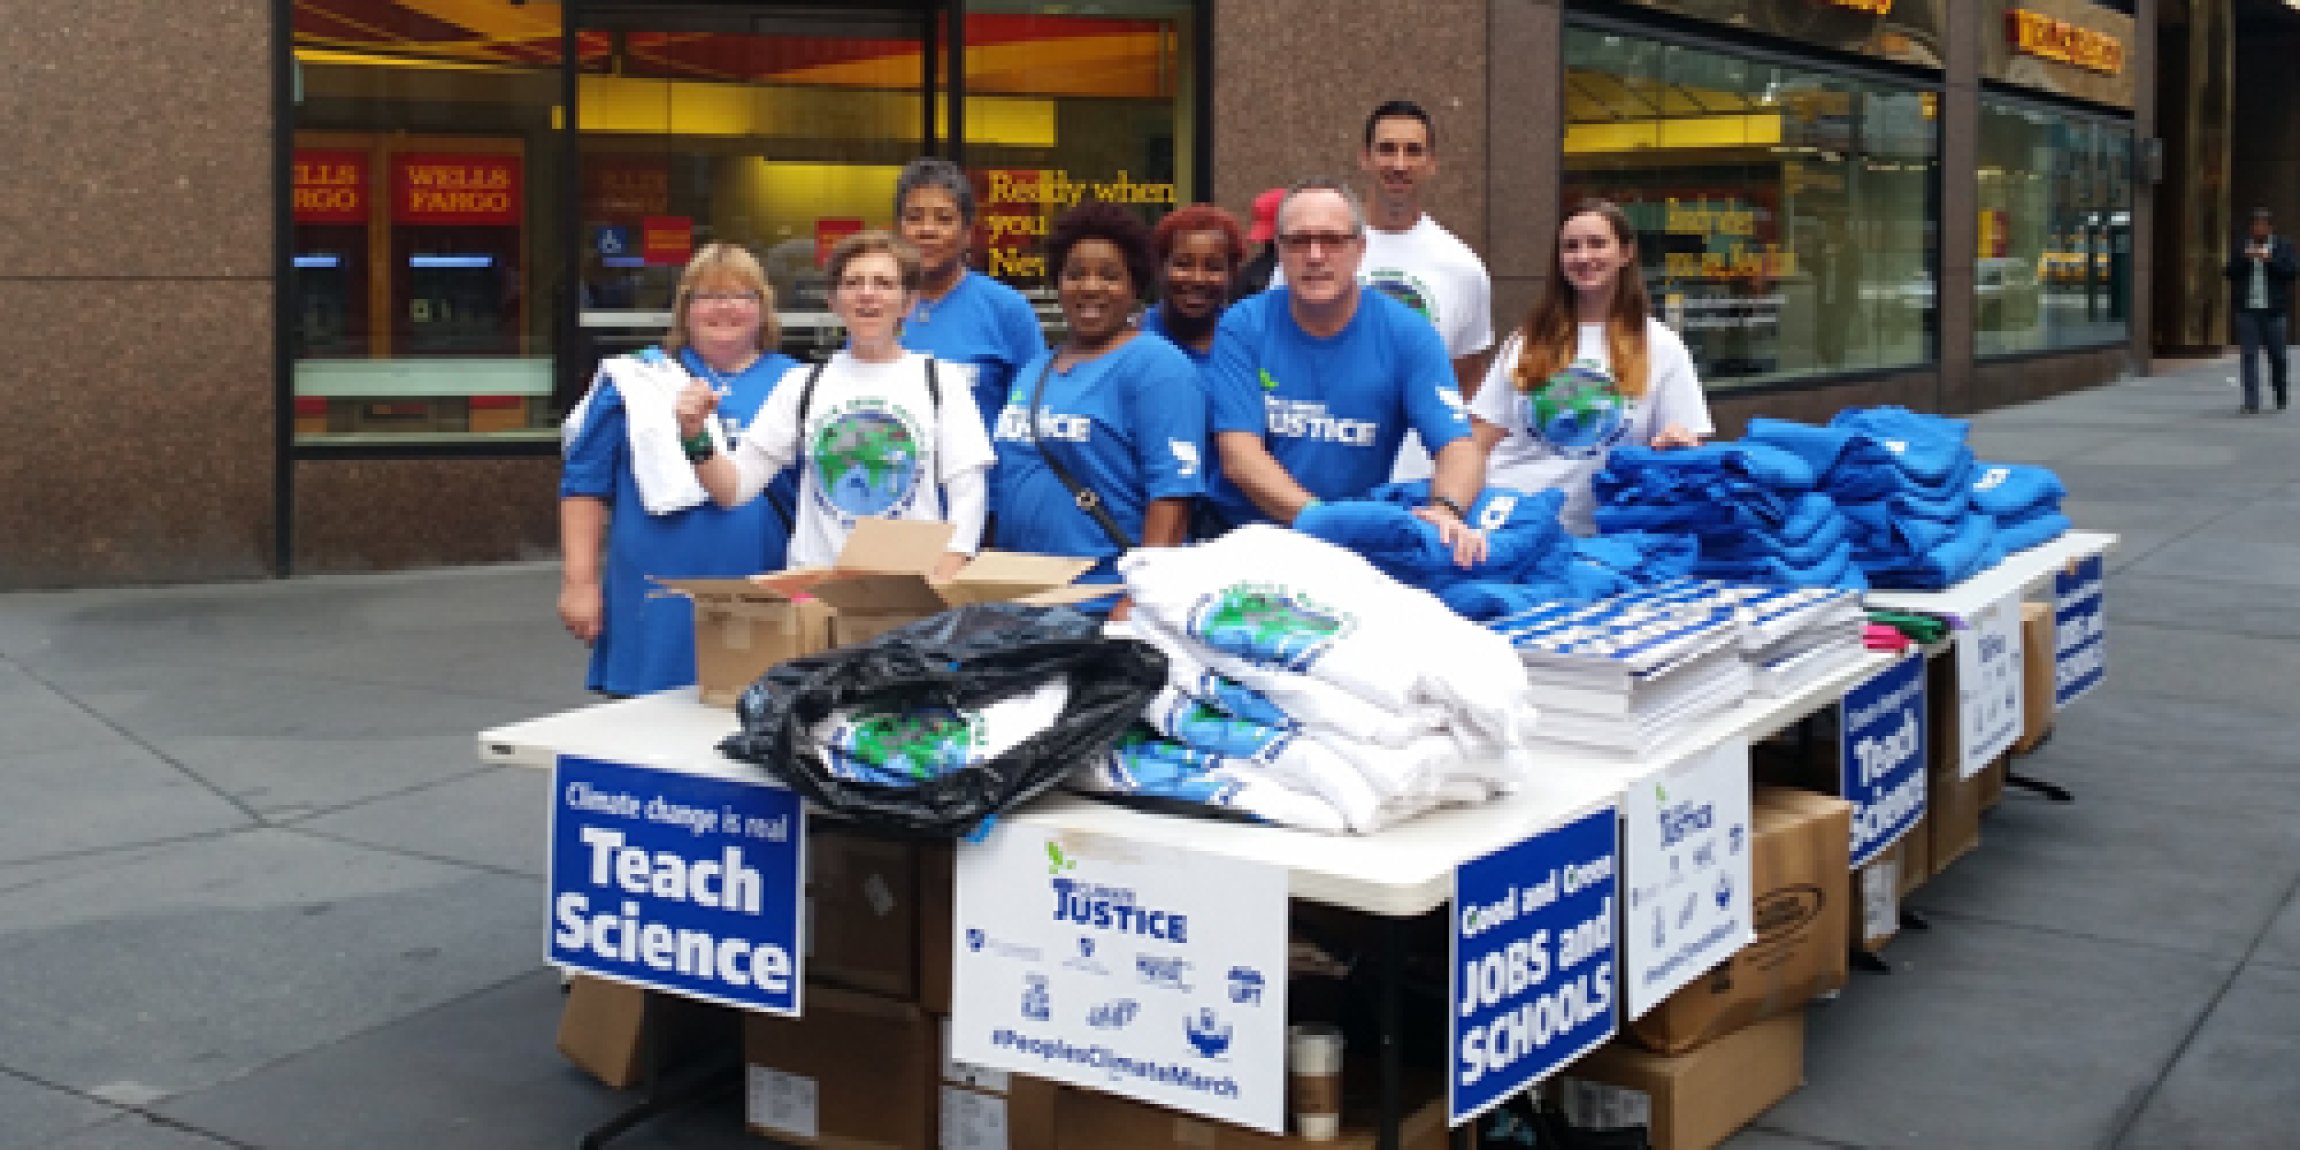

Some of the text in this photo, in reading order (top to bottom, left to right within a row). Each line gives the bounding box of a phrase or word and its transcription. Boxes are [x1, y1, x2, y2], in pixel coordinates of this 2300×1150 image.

[292, 163, 358, 187] ELLS
[292, 187, 358, 212] RGO
[407, 164, 511, 189] WELLS
[409, 189, 510, 214] FARGO
[987, 168, 1177, 207] Ready when
[1267, 394, 1379, 447] USTICE
[564, 781, 789, 843] Climate change is real
[580, 824, 764, 916] Teach
[1050, 878, 1188, 944] JUSTICE
[1460, 885, 1518, 938] Good
[1521, 868, 1559, 915] and
[554, 891, 793, 995] Science
[1460, 928, 1550, 1018] JOBS
[1557, 895, 1611, 971] and
[1460, 960, 1612, 1087] SCHOOLS
